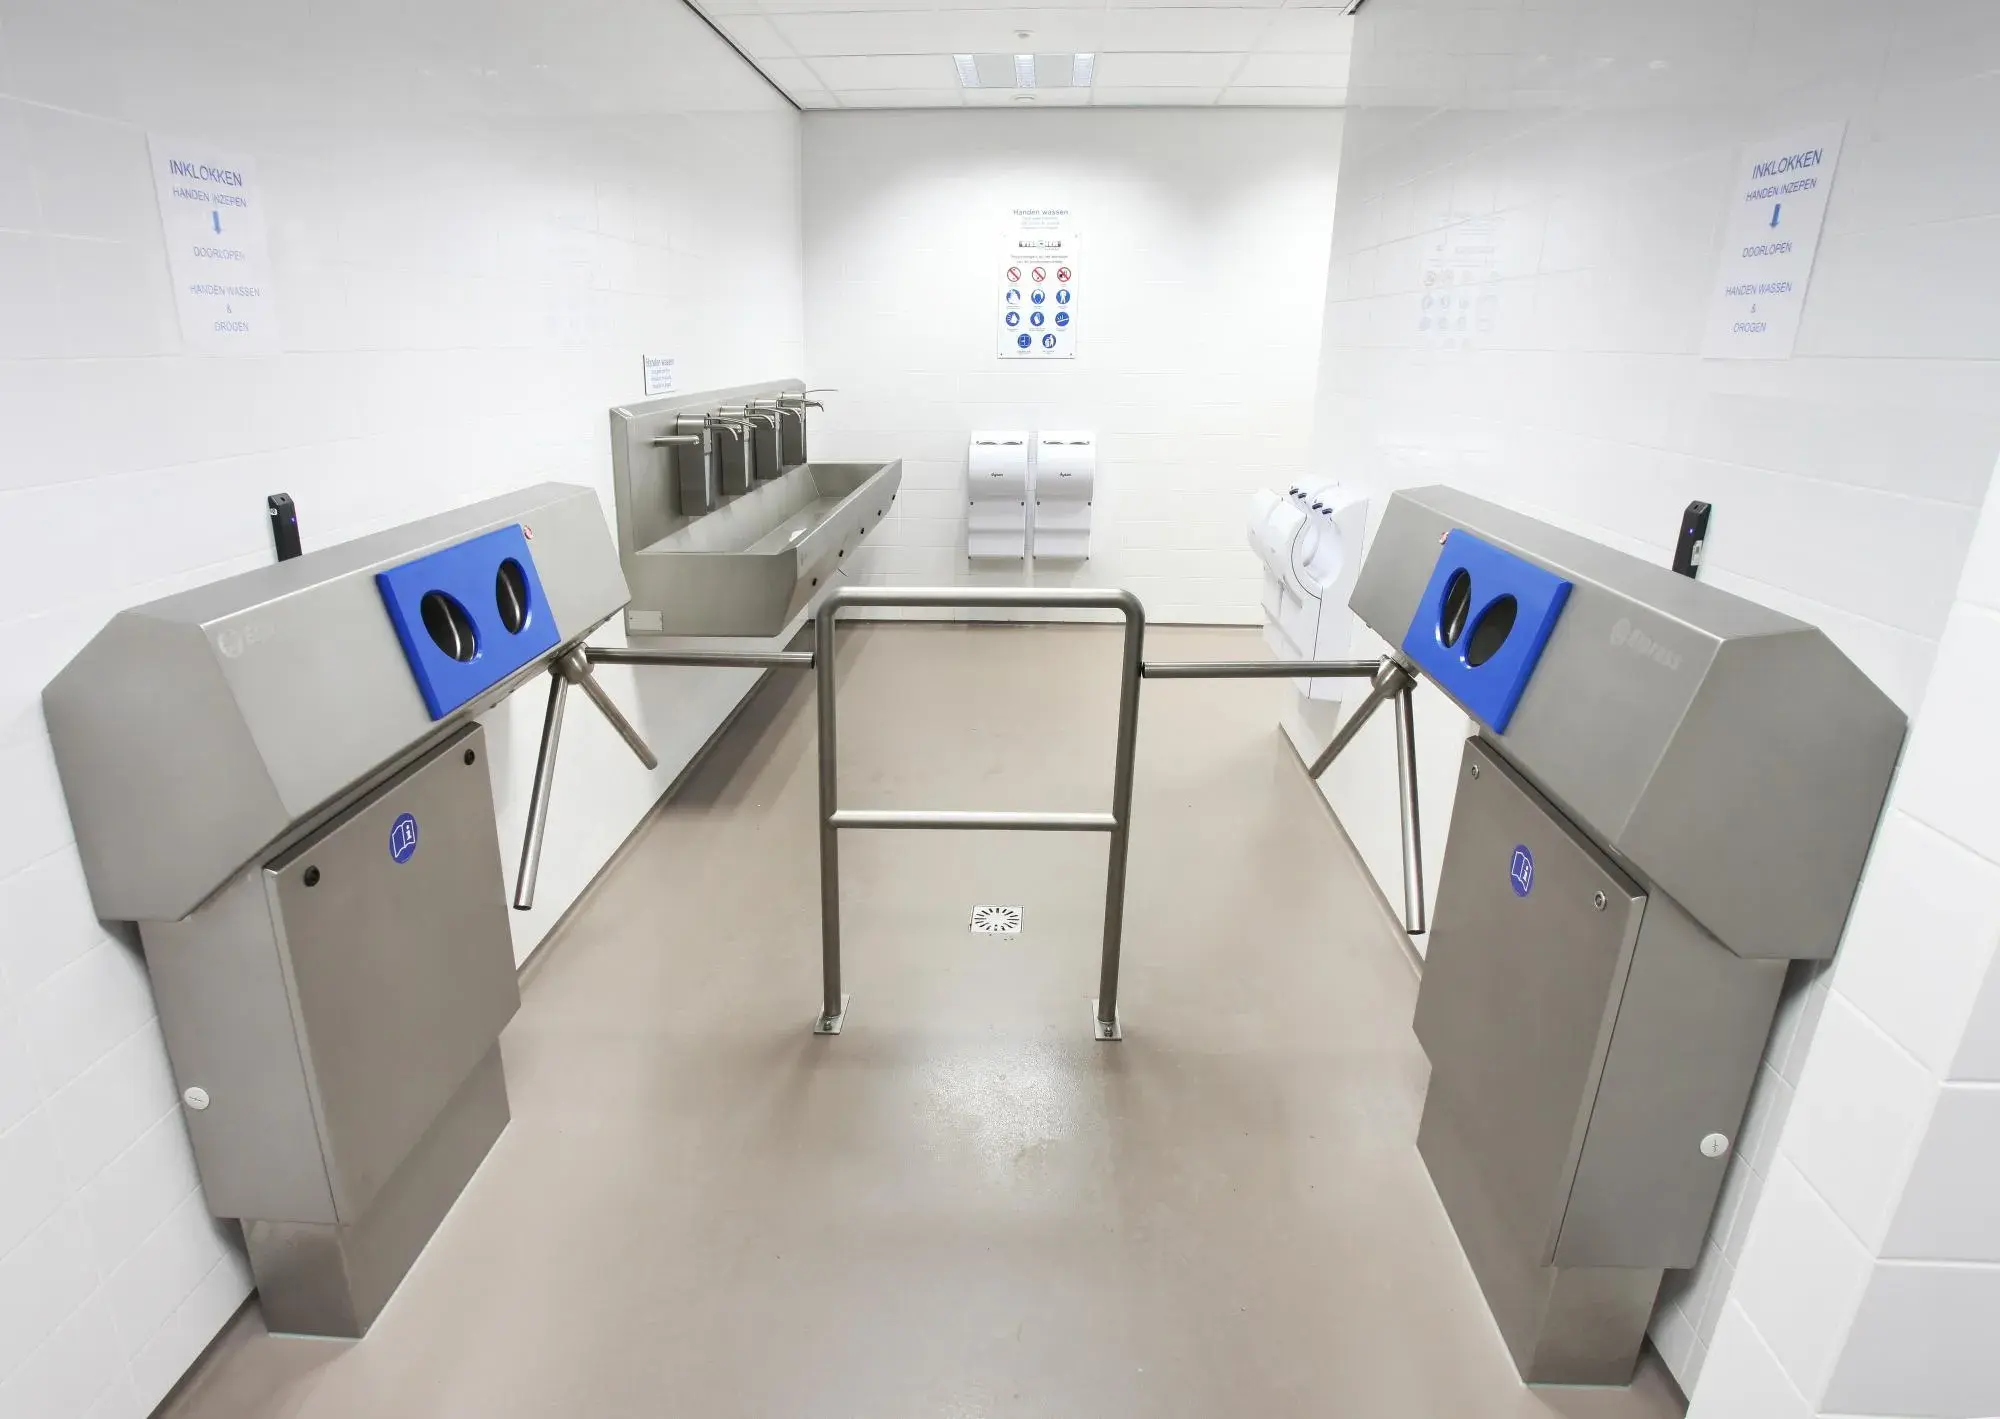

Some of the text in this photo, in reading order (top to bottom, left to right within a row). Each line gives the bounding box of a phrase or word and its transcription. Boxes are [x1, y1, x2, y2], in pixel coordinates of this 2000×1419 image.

[1752, 148, 1823, 179] INKLOKKEN
[169, 160, 242, 186] INKLOKKEN
[173, 187, 247, 207] HANDEN INZEPEN
[1745, 178, 1817, 201] HANDEN INZEPEN
[193, 246, 245, 261] DOORLOPEN
[1742, 242, 1792, 258] DOORLOPEN
[190, 284, 260, 297] HANDEN WASSEN
[1725, 282, 1792, 296] HANDEN WASSEN
[1733, 322, 1767, 333] DROGEN
